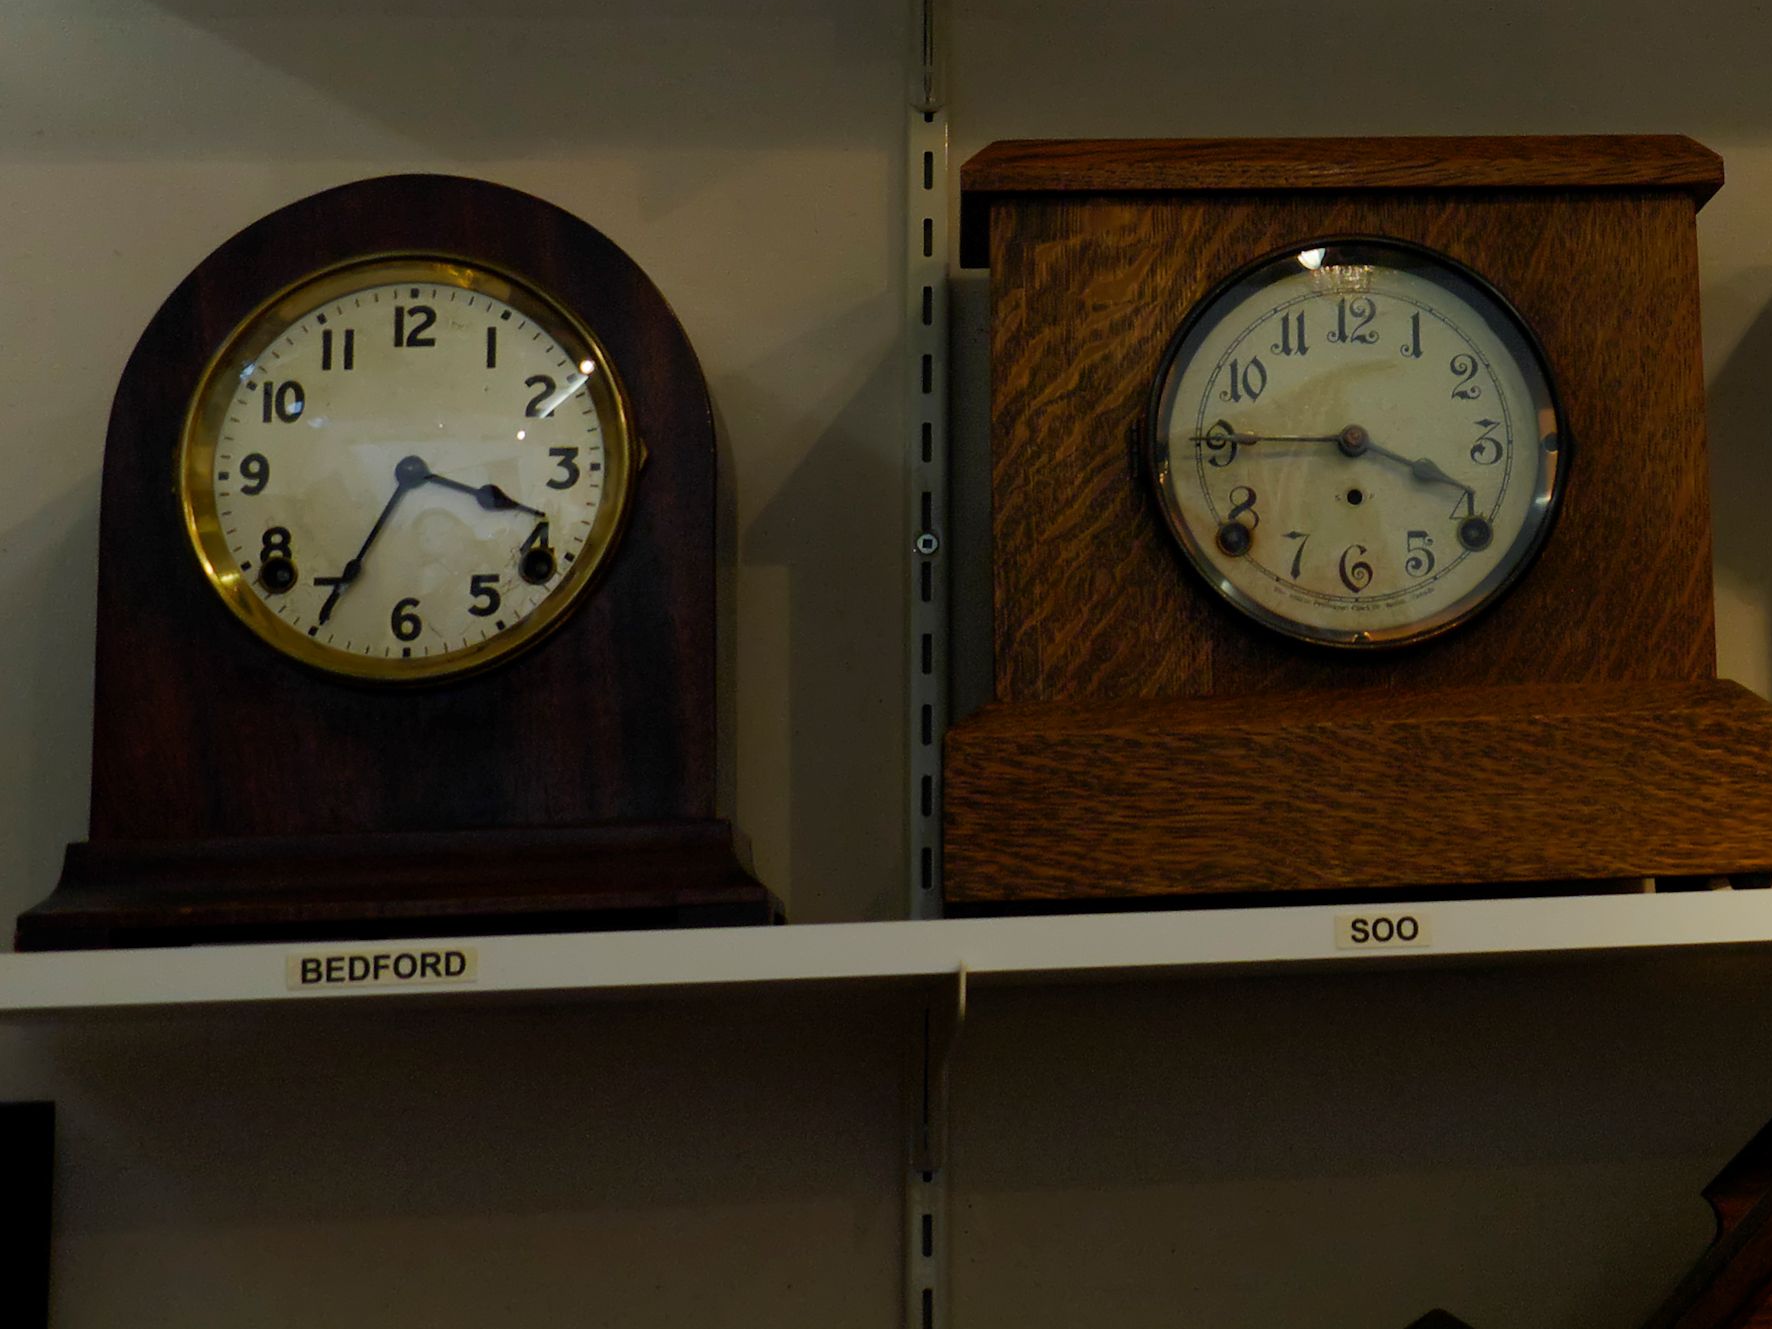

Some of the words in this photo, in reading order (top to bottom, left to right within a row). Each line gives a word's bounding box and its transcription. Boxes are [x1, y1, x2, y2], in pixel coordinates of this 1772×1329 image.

[393, 305, 437, 347] 12
[1269, 311, 1309, 357] 11
[1326, 297, 1380, 345] 12
[1399, 311, 1424, 359] 1
[321, 328, 355, 371] 11
[486, 326, 496, 368] 1
[524, 374, 556, 418] 2
[1218, 355, 1267, 404] 10
[1449, 354, 1482, 400] 2
[261, 380, 305, 424] 10
[1204, 418, 1238, 469] 9
[1469, 417, 1503, 465] 3
[239, 453, 270, 496] 9
[546, 446, 580, 490] 3
[1227, 485, 1260, 529] 8
[1448, 487, 1476, 520] 4
[260, 527, 292, 565] 8
[519, 521, 555, 555] 4
[1281, 530, 1311, 580] 7
[1405, 530, 1436, 577] 5
[1338, 543, 1374, 593] 6
[468, 574, 500, 617] 5
[390, 598, 422, 641] 6
[1351, 916, 1419, 943] SOO
[301, 951, 467, 984] BEDFORD
